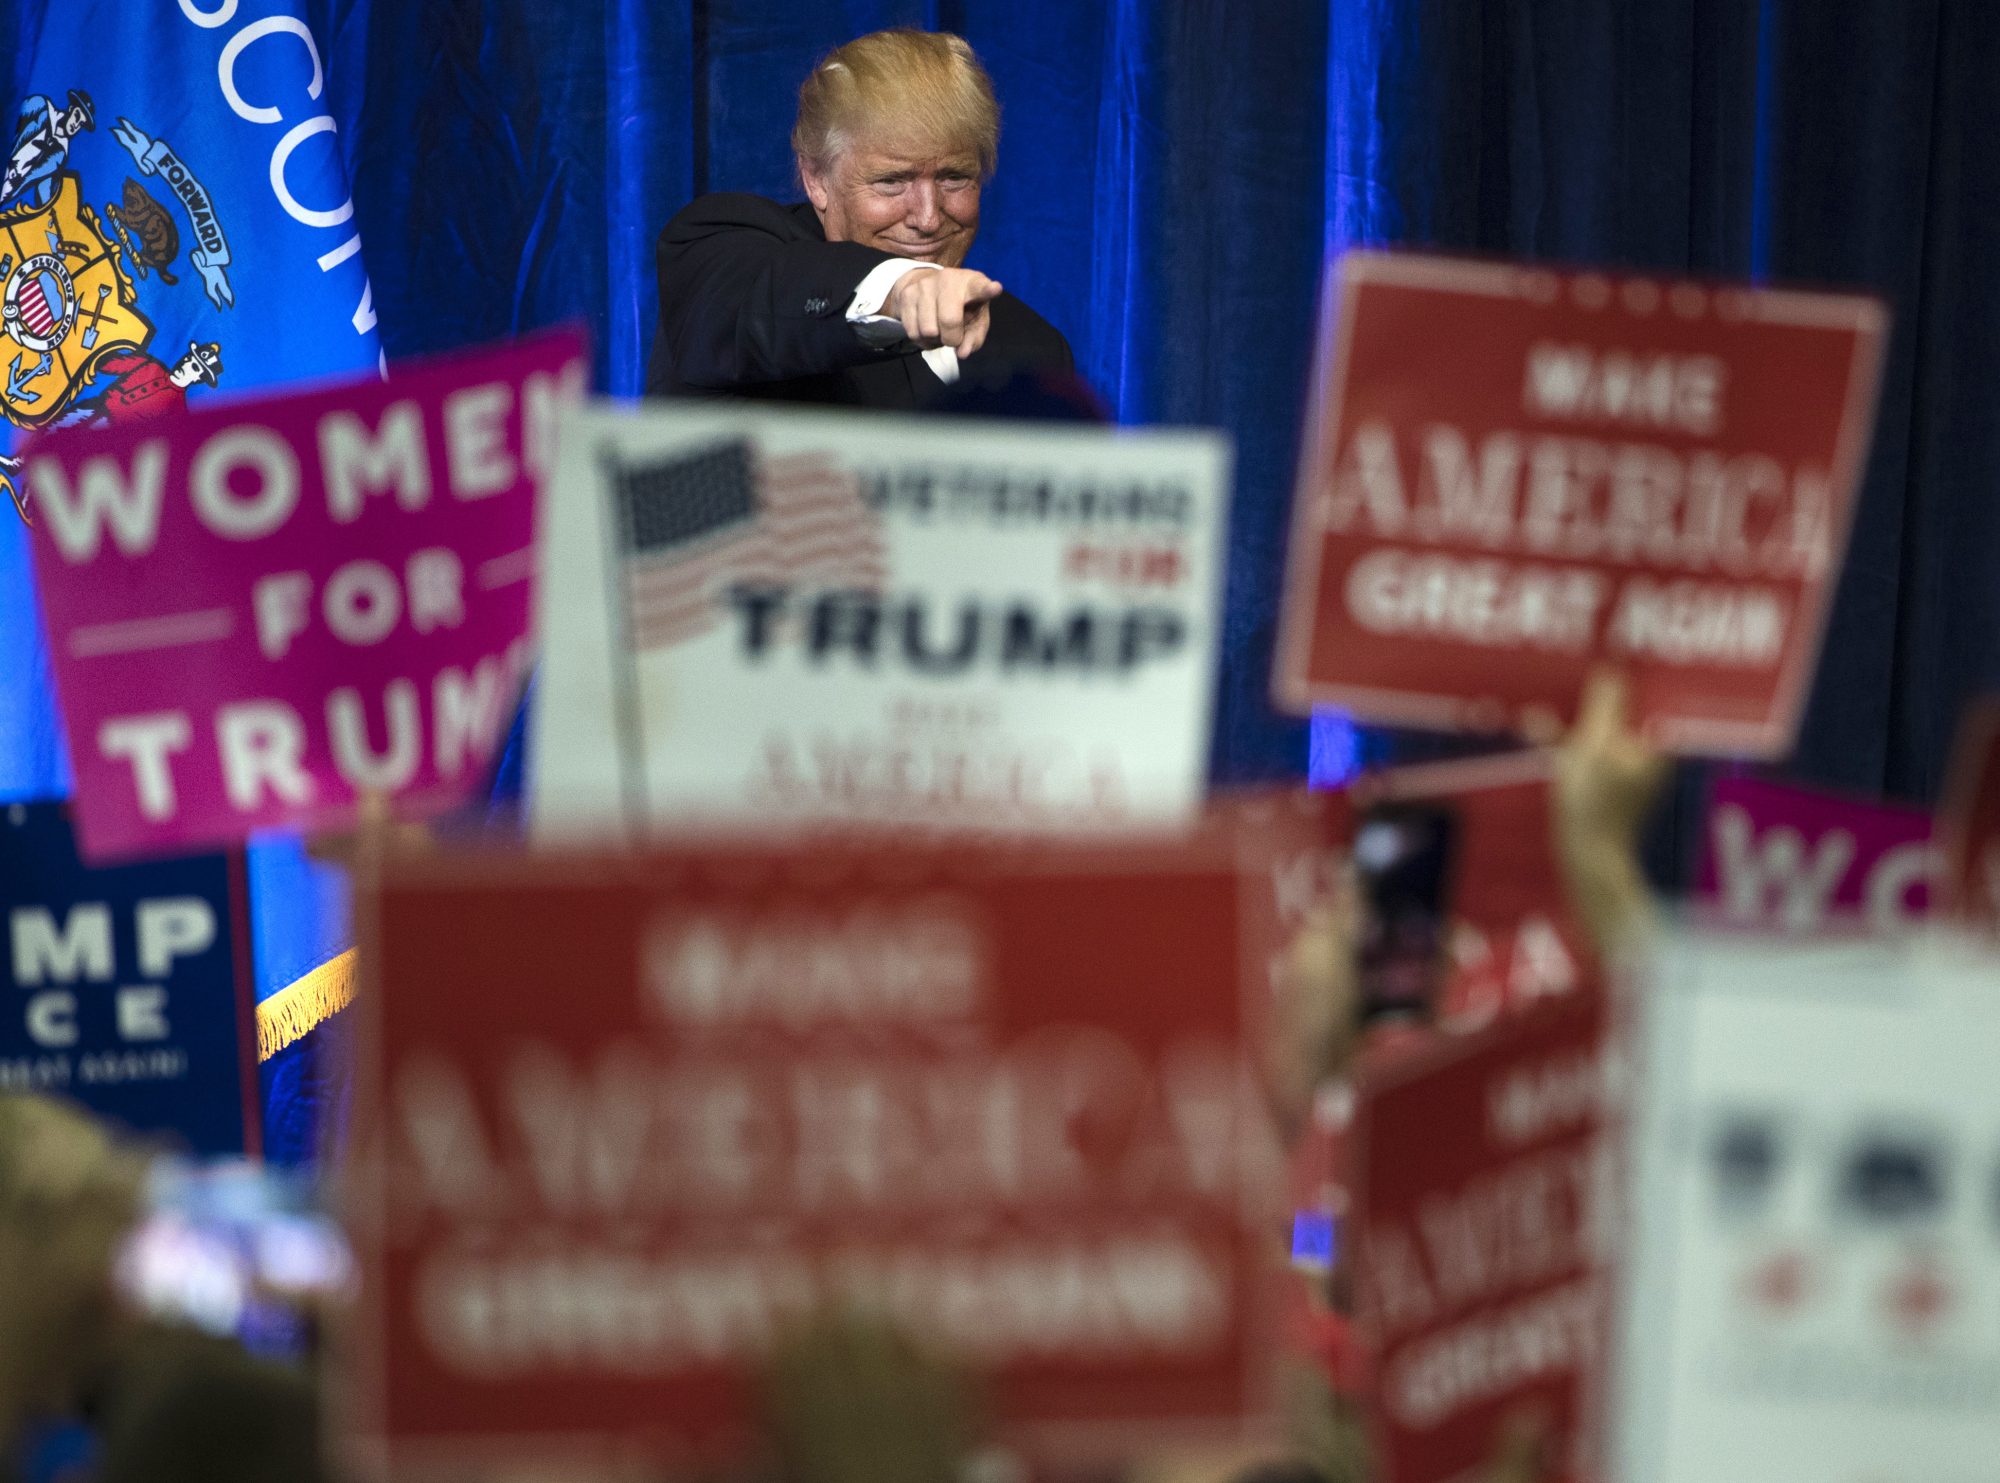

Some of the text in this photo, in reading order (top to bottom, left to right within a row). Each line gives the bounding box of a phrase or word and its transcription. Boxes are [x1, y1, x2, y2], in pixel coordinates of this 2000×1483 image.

[157, 153, 222, 253] FORWARD
[31, 257, 74, 303] PLURIBUS
[1328, 422, 1832, 580] AMERICA
[253, 548, 465, 659] FOR
[731, 584, 1191, 682] TRUMP
[100, 650, 525, 820] TRUM
[9, 896, 217, 987] MP
[26, 985, 170, 1047] CE
